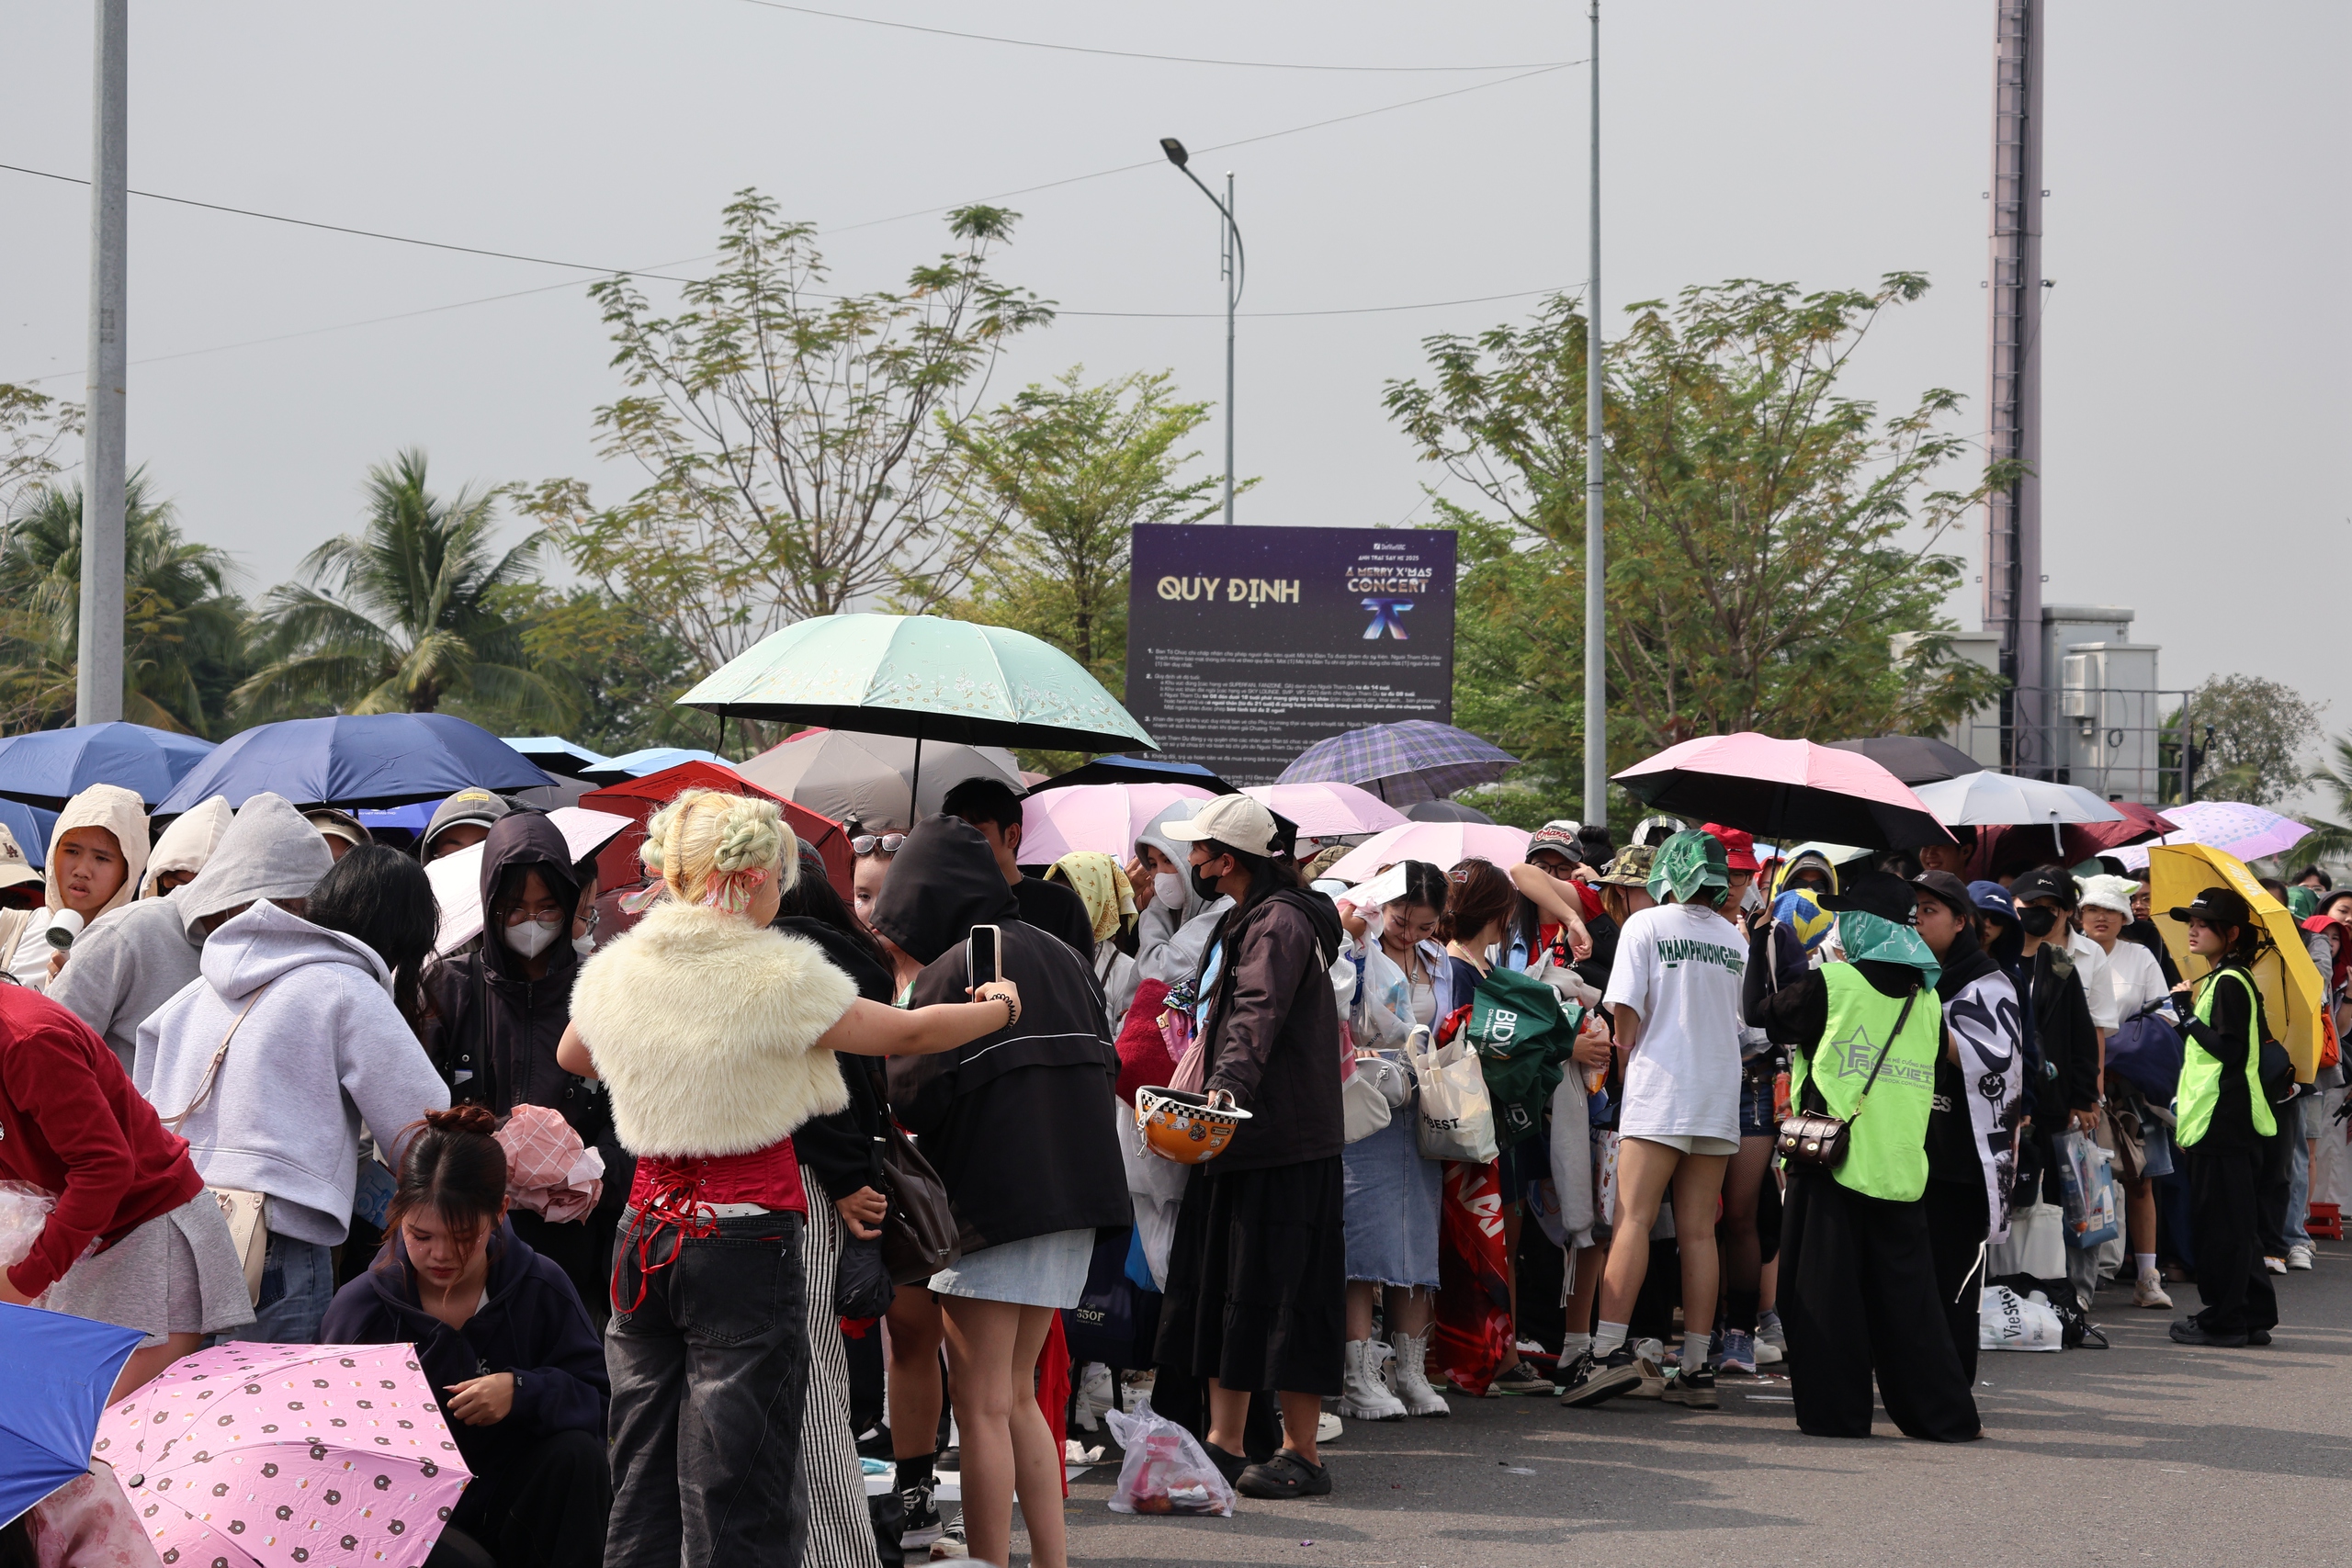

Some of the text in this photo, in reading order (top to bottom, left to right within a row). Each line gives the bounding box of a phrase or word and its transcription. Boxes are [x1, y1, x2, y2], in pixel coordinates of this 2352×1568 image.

[1347, 577, 1430, 593] CONCERT
[1358, 567, 1394, 577] MERRY
[1396, 567, 1432, 578] X'MAS
[1157, 575, 1300, 609] QUY ĐỊNH
[1488, 1009, 1518, 1057] BIDV
